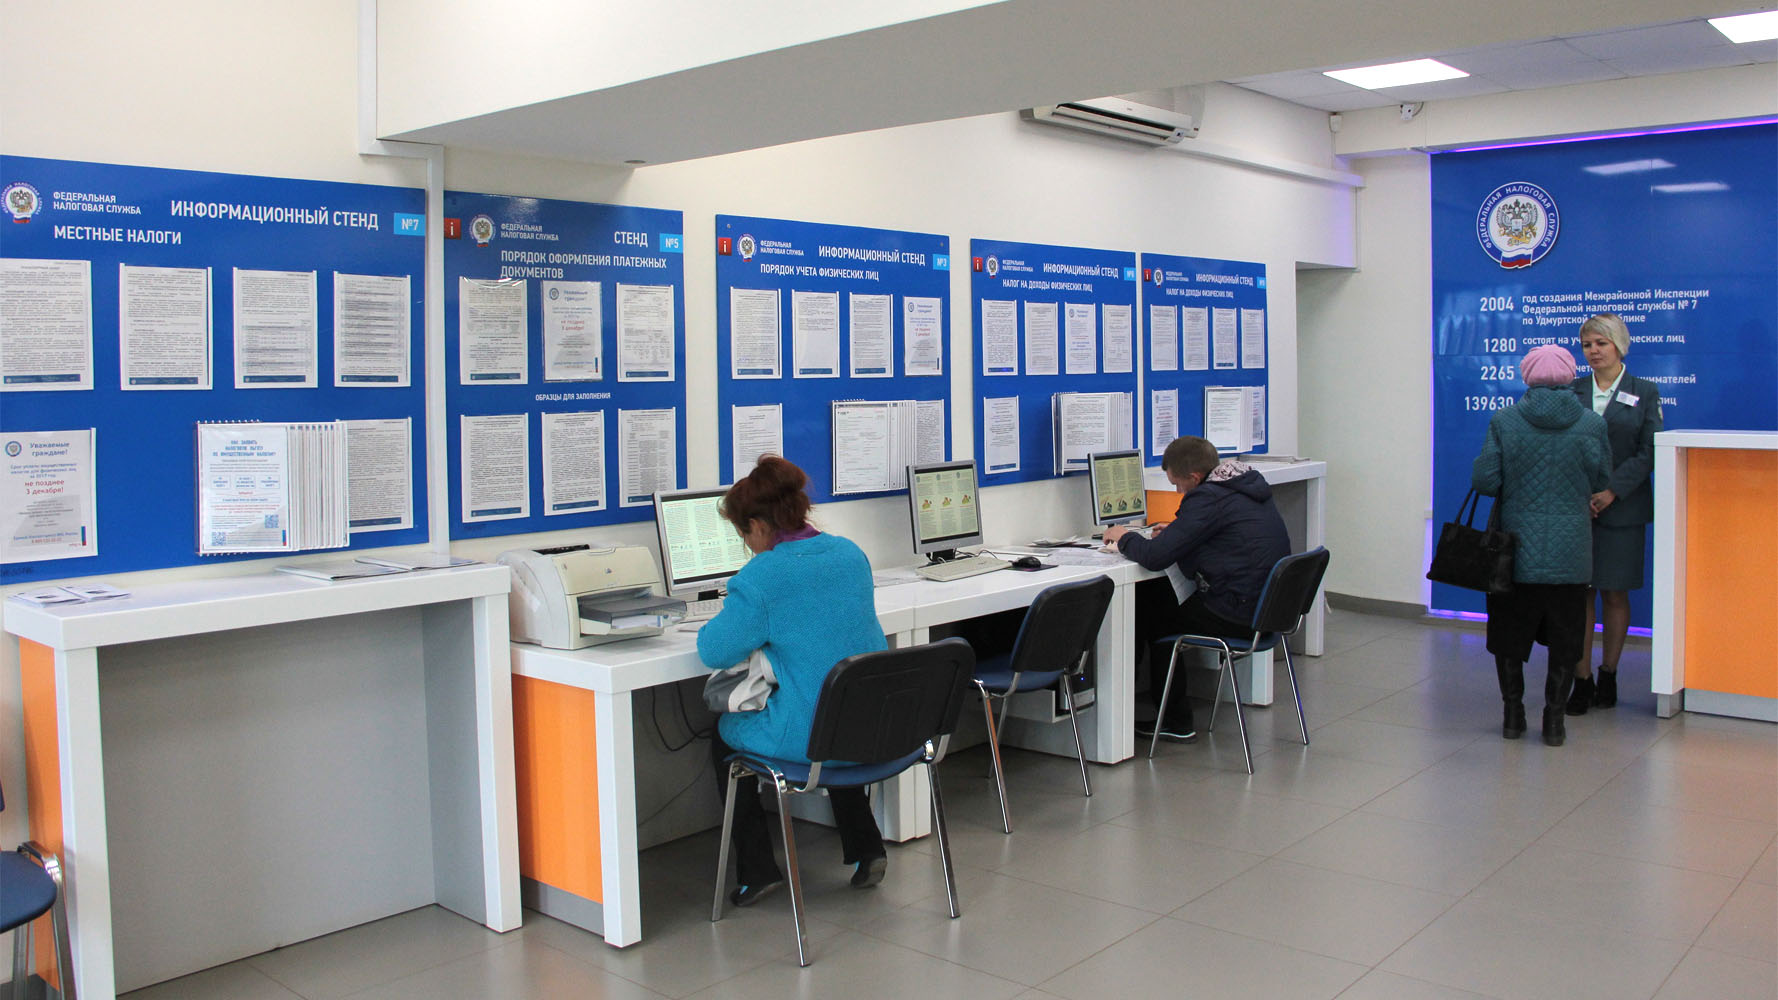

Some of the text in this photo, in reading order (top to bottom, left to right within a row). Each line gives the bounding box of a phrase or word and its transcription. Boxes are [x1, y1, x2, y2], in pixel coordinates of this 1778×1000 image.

[53, 191, 117, 204] ФЕДЕРАЛЬНАЯ
[53, 201, 141, 215] НАЛОГОВАЯ СЛУЖБА
[171, 200, 379, 231] ИНФОРМАЦИОННЫЙ СТЕНД
[1480, 185, 1556, 249] ФЕДЕРАЛЬНАЯ НАЛОГОВАЯ СЛУЖБА
[401, 218, 419, 231] №7
[500, 223, 543, 232] ФЕДЕРАЛЬНАЯ
[54, 225, 182, 246] МЕСТНЫЕ НАЛОГИ
[500, 231, 559, 241] НАЛОГОВАЯ СЛУЖБА
[614, 231, 648, 247] СТЕНД
[665, 237, 679, 249] №5
[501, 250, 667, 269] ПОРЯДОК ОФОРМЛЕНИЯ ПЛАТЕЖНЫХ
[819, 245, 925, 266] ИНФОРМАЦИОННЫЙ СТЕНД
[500, 265, 564, 279] ДОКУМЕНТОВ
[760, 263, 879, 282] ПОРЯДОК УЧЕТА ФИЗИЧЕСКИХ ЛИЦ
[1043, 262, 1119, 279] ИНФОРМАЦИОННЫЙ СТЕНД
[1002, 279, 1019, 288] НАЛОГ
[1020, 280, 1028, 288] НА
[1028, 280, 1050, 290] ДОХОДЫ
[1051, 281, 1082, 291] ФИЗИЧЕСКИХ
[1522, 288, 1709, 304] год создания Межрайонной Инспекции
[1480, 296, 1514, 312] 2004
[1522, 299, 1698, 315] Федеральной налоговой службы № 7
[1522, 317, 1533, 325] по
[1535, 313, 1588, 326] Удмуртской
[1483, 338, 1517, 352] 1280
[1522, 336, 1555, 345] состоят
[1558, 336, 1569, 344] на
[1629, 335, 1663, 343] ческих
[1665, 335, 1686, 344] лиц
[1480, 366, 1514, 380] 2265
[535, 392, 611, 401] ОБРАЗЦЫ ДЛЯ ЗАПОЛНЕНИЯ
[1464, 396, 1514, 411] 139630
[30, 441, 70, 449] Уважаемые
[32, 449, 68, 458] граждане!
[35, 479, 65, 488] позднее
[32, 486, 64, 496] декабря!
